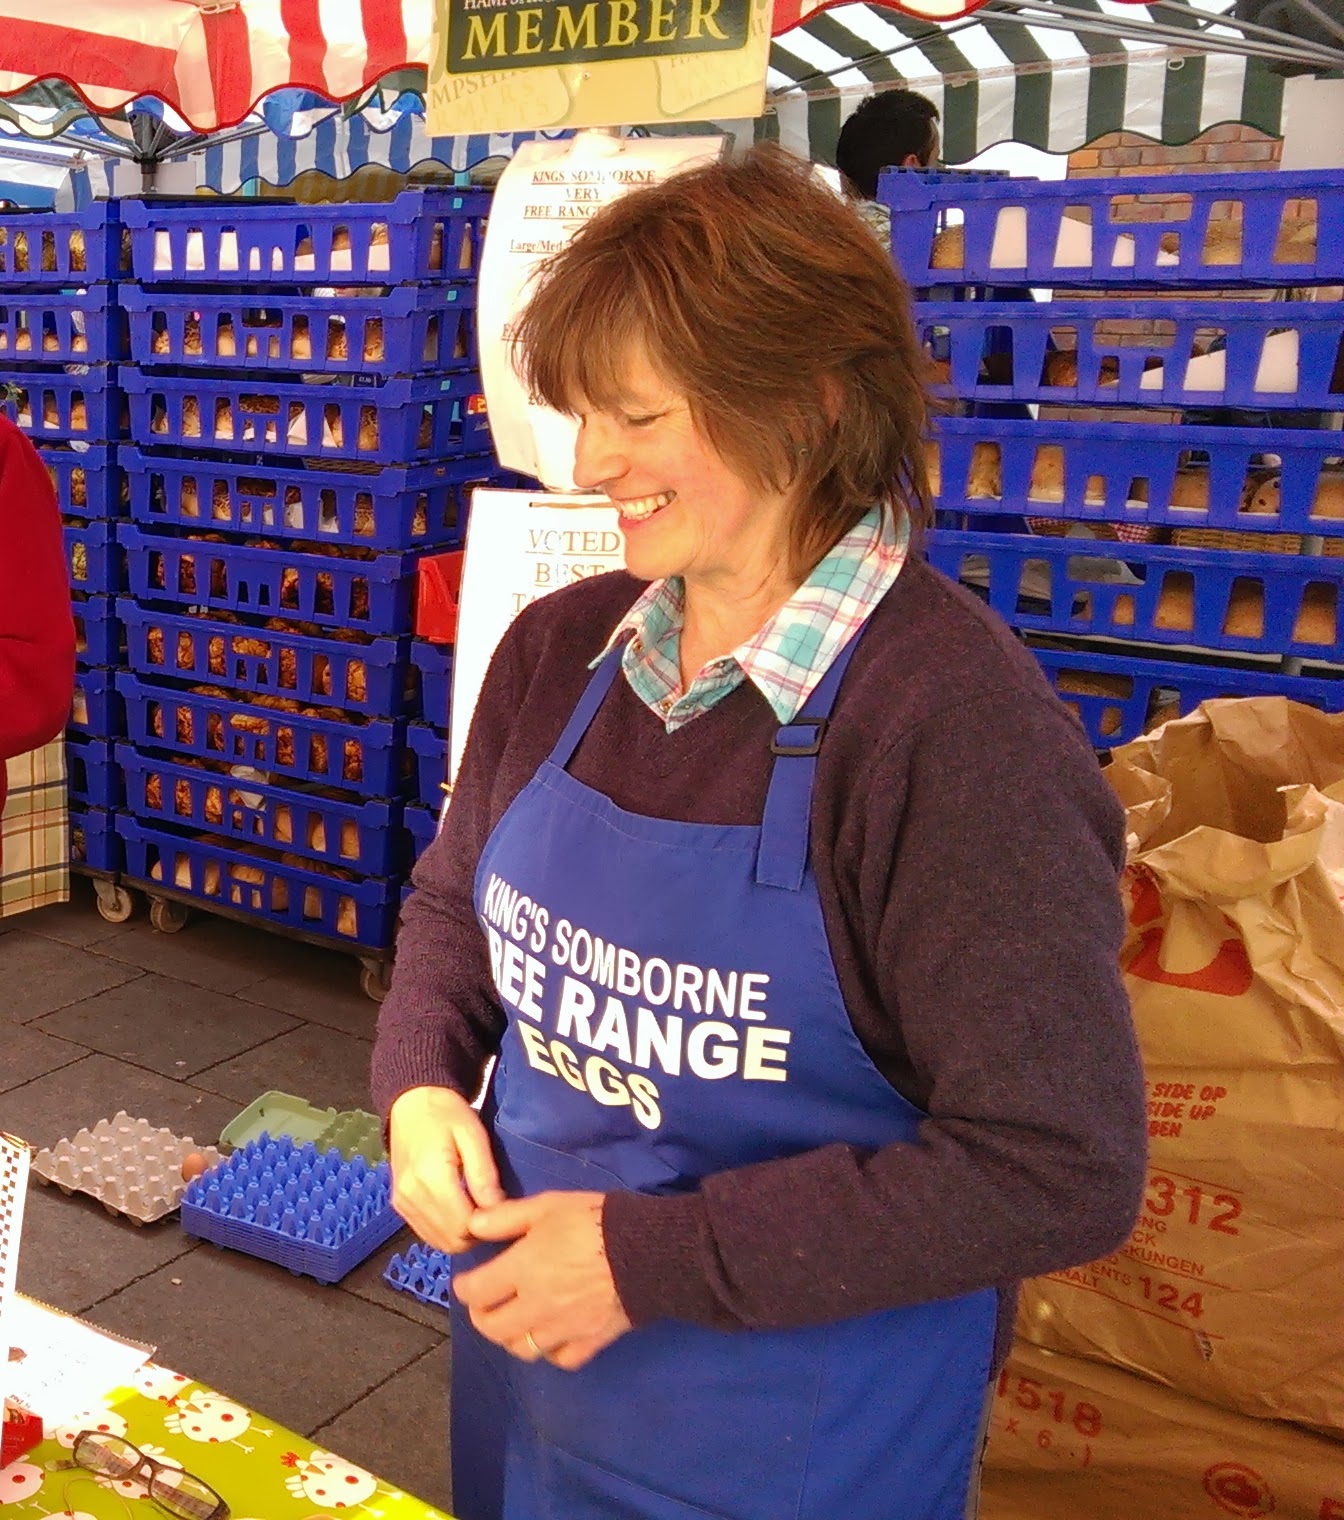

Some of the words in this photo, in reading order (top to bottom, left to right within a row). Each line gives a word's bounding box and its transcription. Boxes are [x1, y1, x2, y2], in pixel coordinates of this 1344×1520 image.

[461, 0, 731, 60] MEMBER
[532, 170, 565, 182] KINGS
[566, 188, 600, 200] VERY
[524, 205, 552, 218] FREE
[558, 205, 600, 218] RANG
[528, 529, 621, 552] VOTED
[483, 872, 549, 954] KING'S
[552, 918, 771, 1022] SOMBORNE
[481, 914, 547, 1023] REE
[556, 975, 792, 1083] RANGE
[517, 1020, 662, 1131] EGGS
[1152, 1082, 1196, 1100] SIDE
[1199, 1085, 1228, 1102] OP
[1189, 1104, 1217, 1121] UP
[1138, 1274, 1205, 1319] 124
